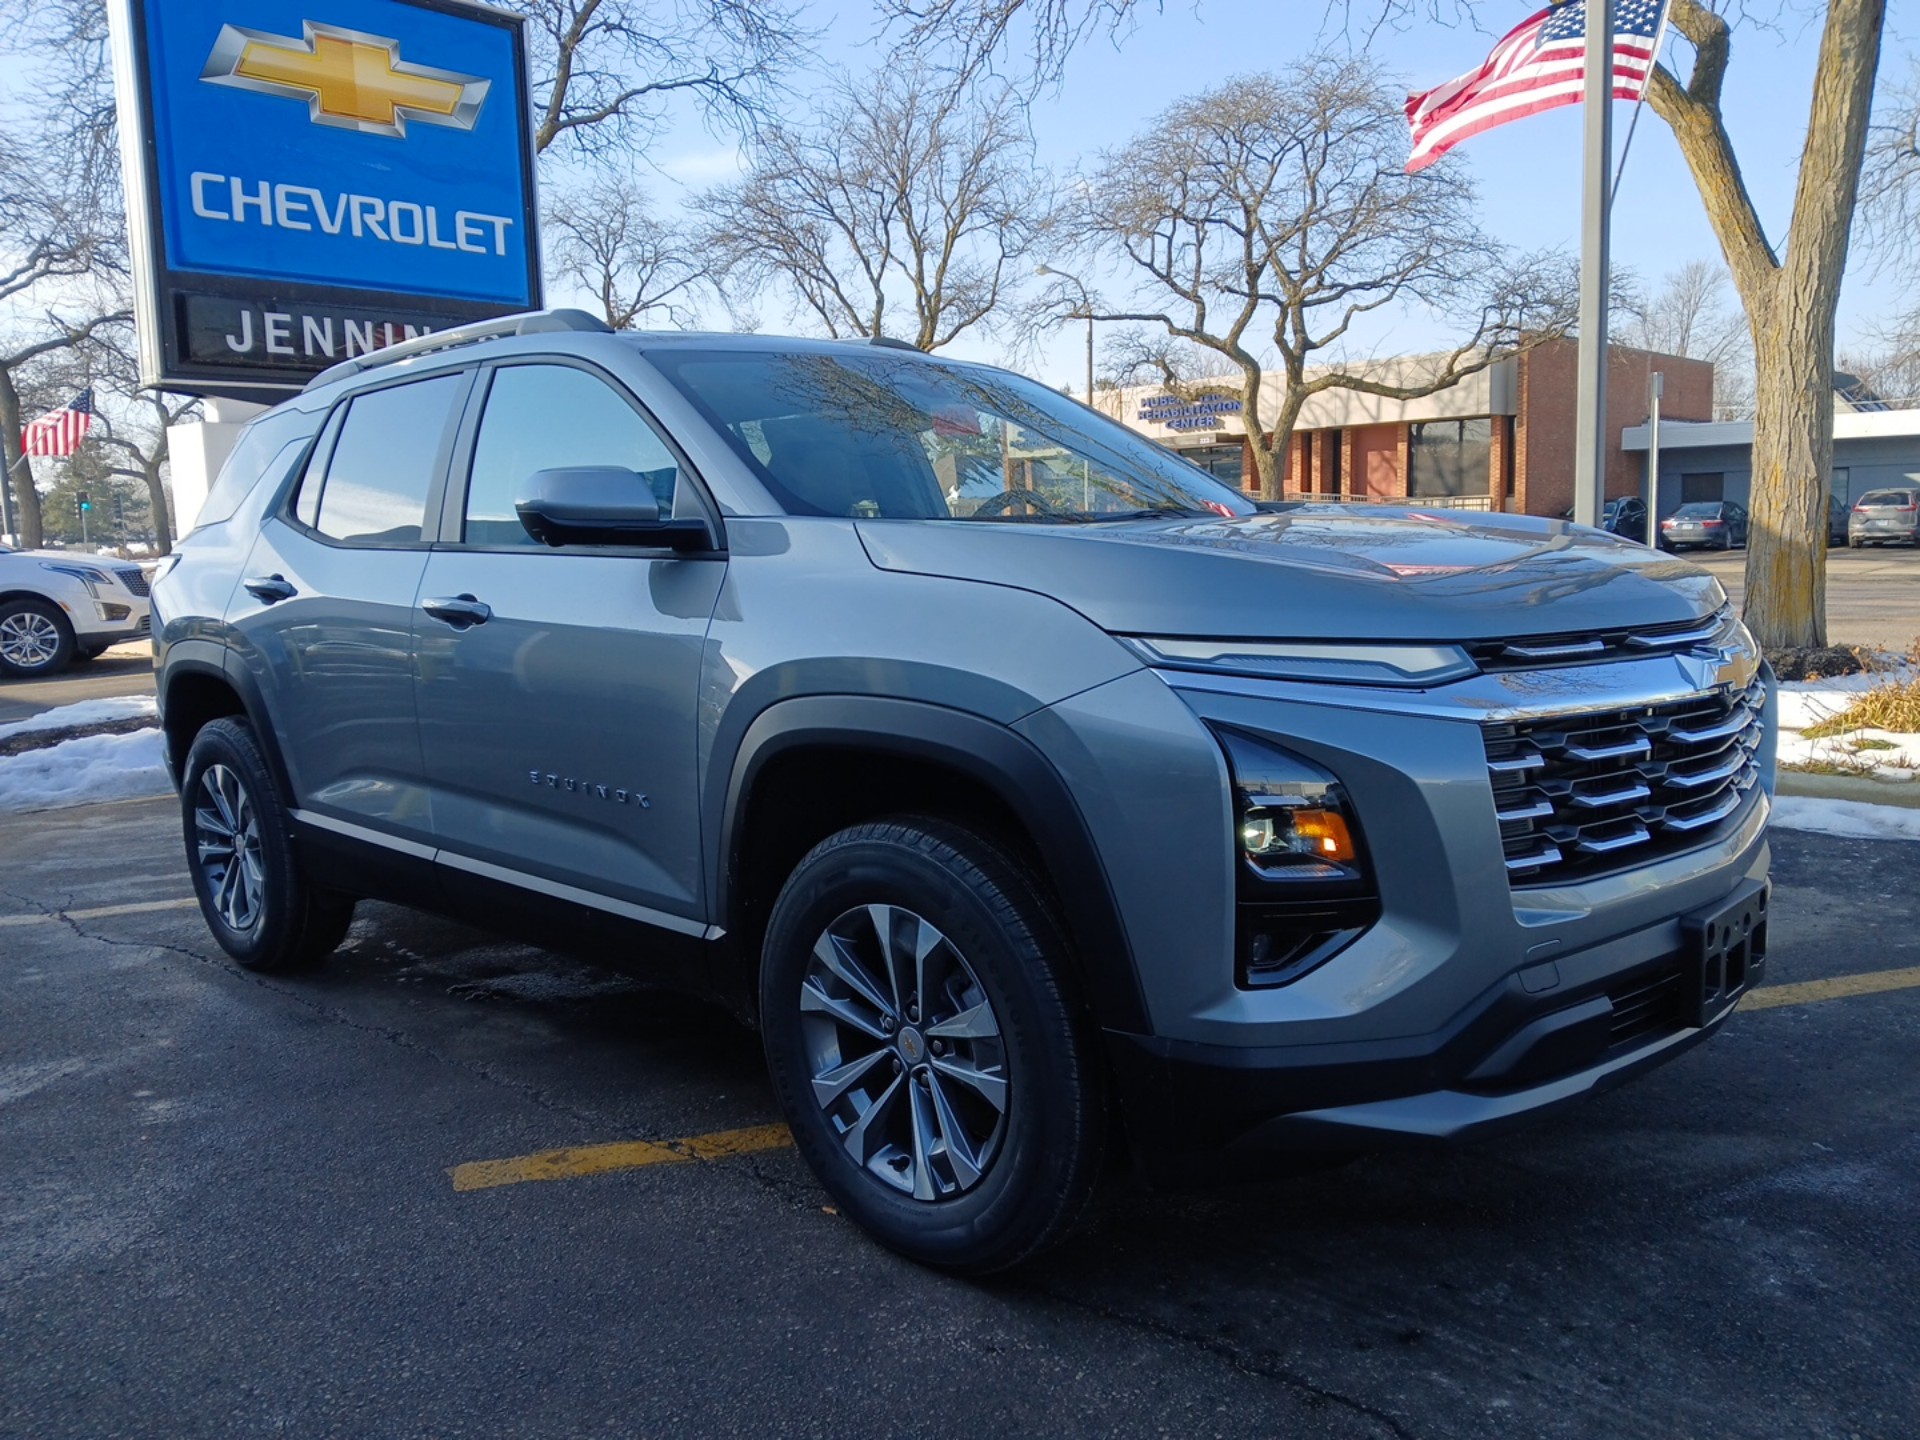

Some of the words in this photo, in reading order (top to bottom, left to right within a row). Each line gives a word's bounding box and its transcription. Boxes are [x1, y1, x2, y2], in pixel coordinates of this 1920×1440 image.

[190, 171, 513, 256] CHEVROLET
[226, 309, 499, 357] JENNIN
[1137, 401, 1243, 420] REHABILITATION
[1166, 415, 1217, 429] CENTER
[530, 771, 649, 808] EQUINOX
